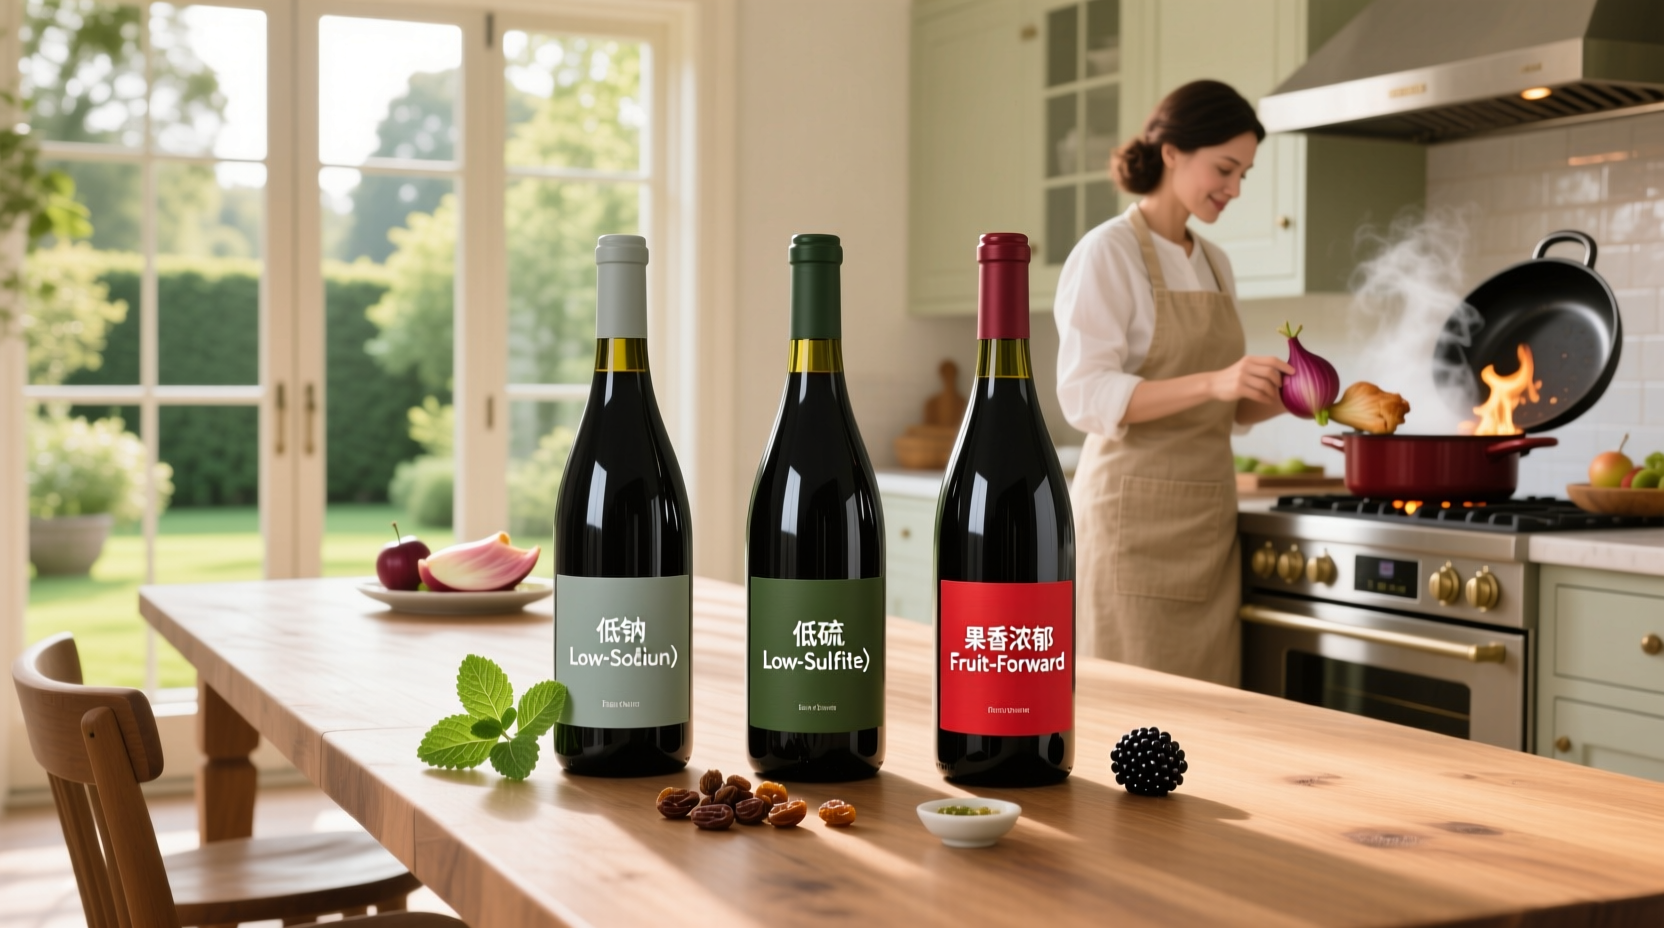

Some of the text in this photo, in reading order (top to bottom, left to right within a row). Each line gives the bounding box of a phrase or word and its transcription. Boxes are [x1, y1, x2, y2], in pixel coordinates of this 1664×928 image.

[792, 618, 845, 647] 低硫
[964, 625, 1054, 652] 果香浓郁
[763, 647, 870, 673] Low-Sulfite)
[950, 651, 1065, 673] Fruit-Forward
